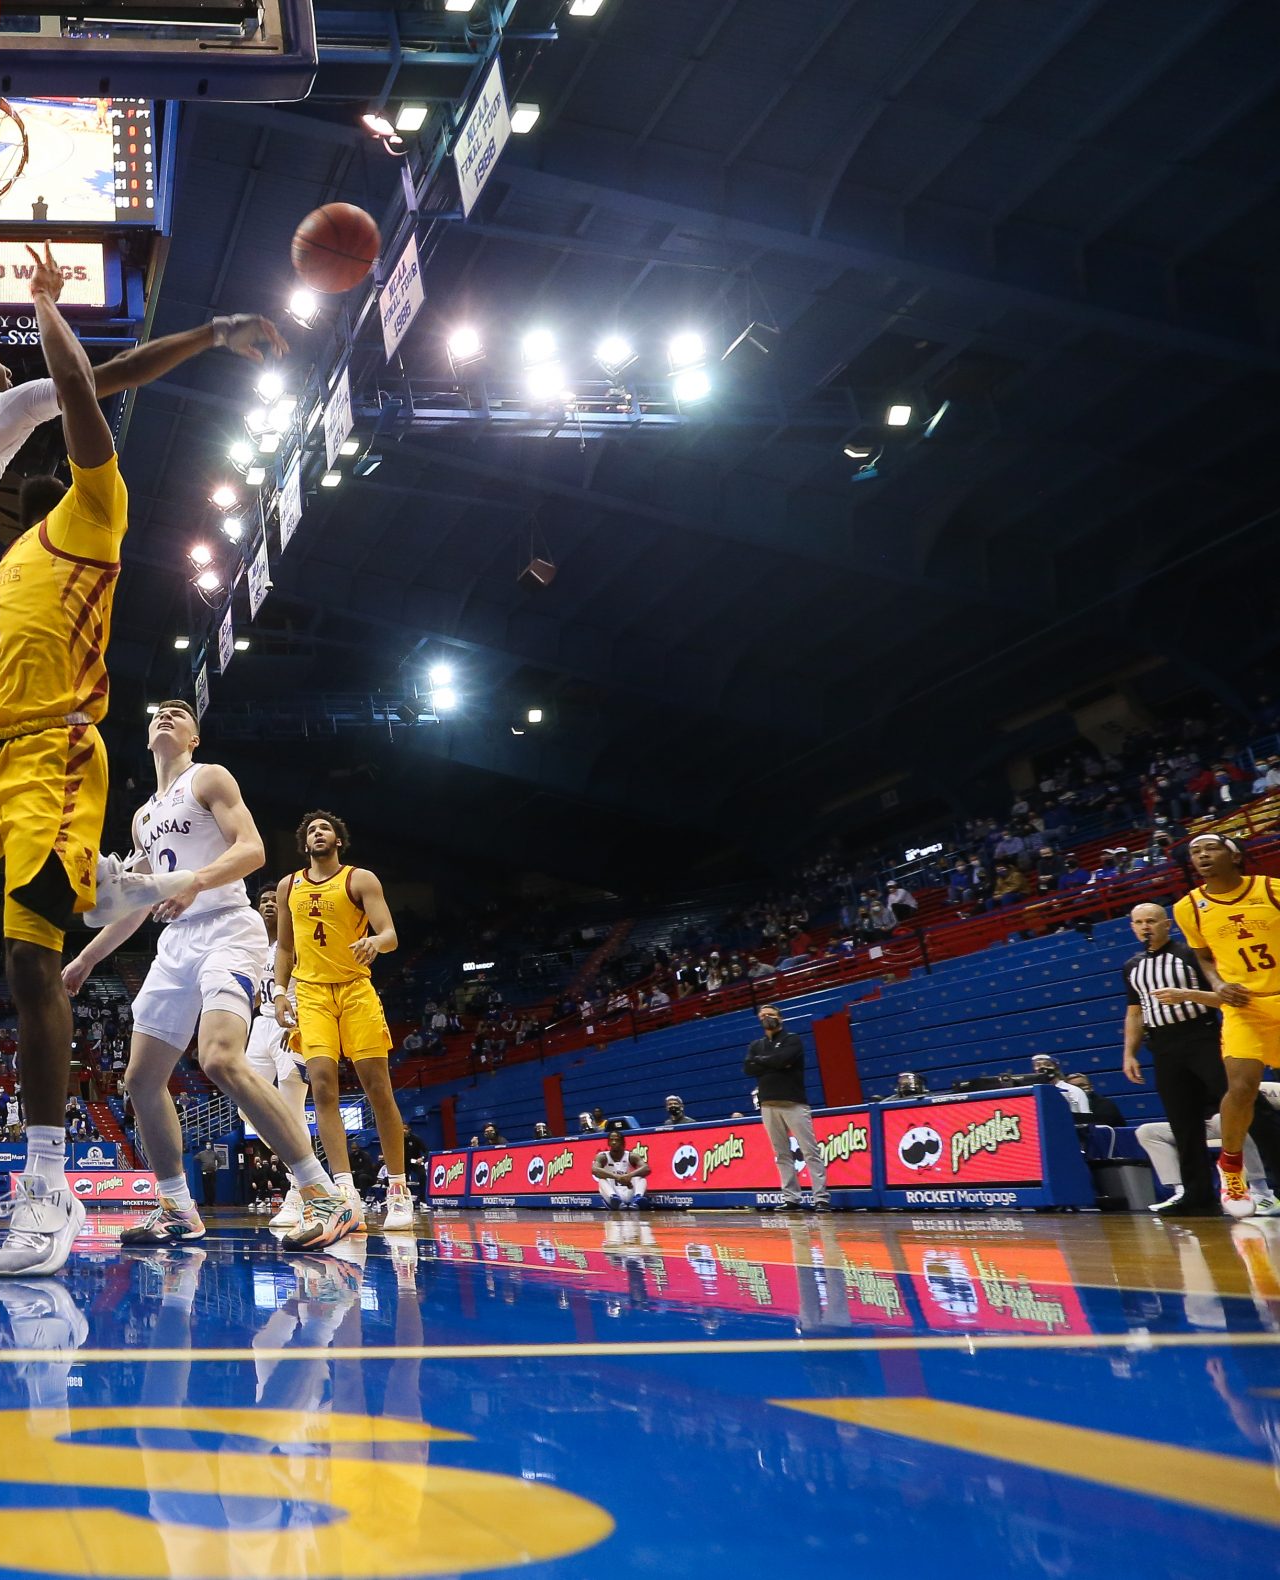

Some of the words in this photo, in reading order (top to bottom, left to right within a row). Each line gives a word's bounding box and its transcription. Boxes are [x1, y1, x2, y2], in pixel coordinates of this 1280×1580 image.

[127, 109, 135, 119] F
[136, 110, 150, 119] PT
[466, 93, 490, 149] NCAA
[145, 126, 151, 138] 1
[459, 136, 483, 183] FINAL
[482, 90, 503, 137] FOUR
[130, 161, 136, 172] 1
[115, 178, 127, 190] 21
[145, 179, 153, 190] 2
[12, 265, 87, 281] WGS
[401, 261, 418, 297] FOUR
[144, 818, 191, 855] KANSAS
[313, 921, 327, 947] 4
[1238, 943, 1277, 973] 13
[950, 1109, 1021, 1174] Pringles
[490, 1153, 513, 1188] Pringles
[546, 1148, 574, 1187] Pringles
[702, 1133, 744, 1183] Pringles
[96, 1176, 123, 1196] Pringles
[445, 1158, 465, 1189] Pringles
[550, 1197, 570, 1205] ROCKET
[570, 1197, 592, 1207] Mortgage
[664, 1195, 693, 1206] Mortgage
[756, 1193, 785, 1204] ROCKE
[906, 1190, 956, 1203] ROCKET
[958, 1191, 1018, 1205] Mortgage
